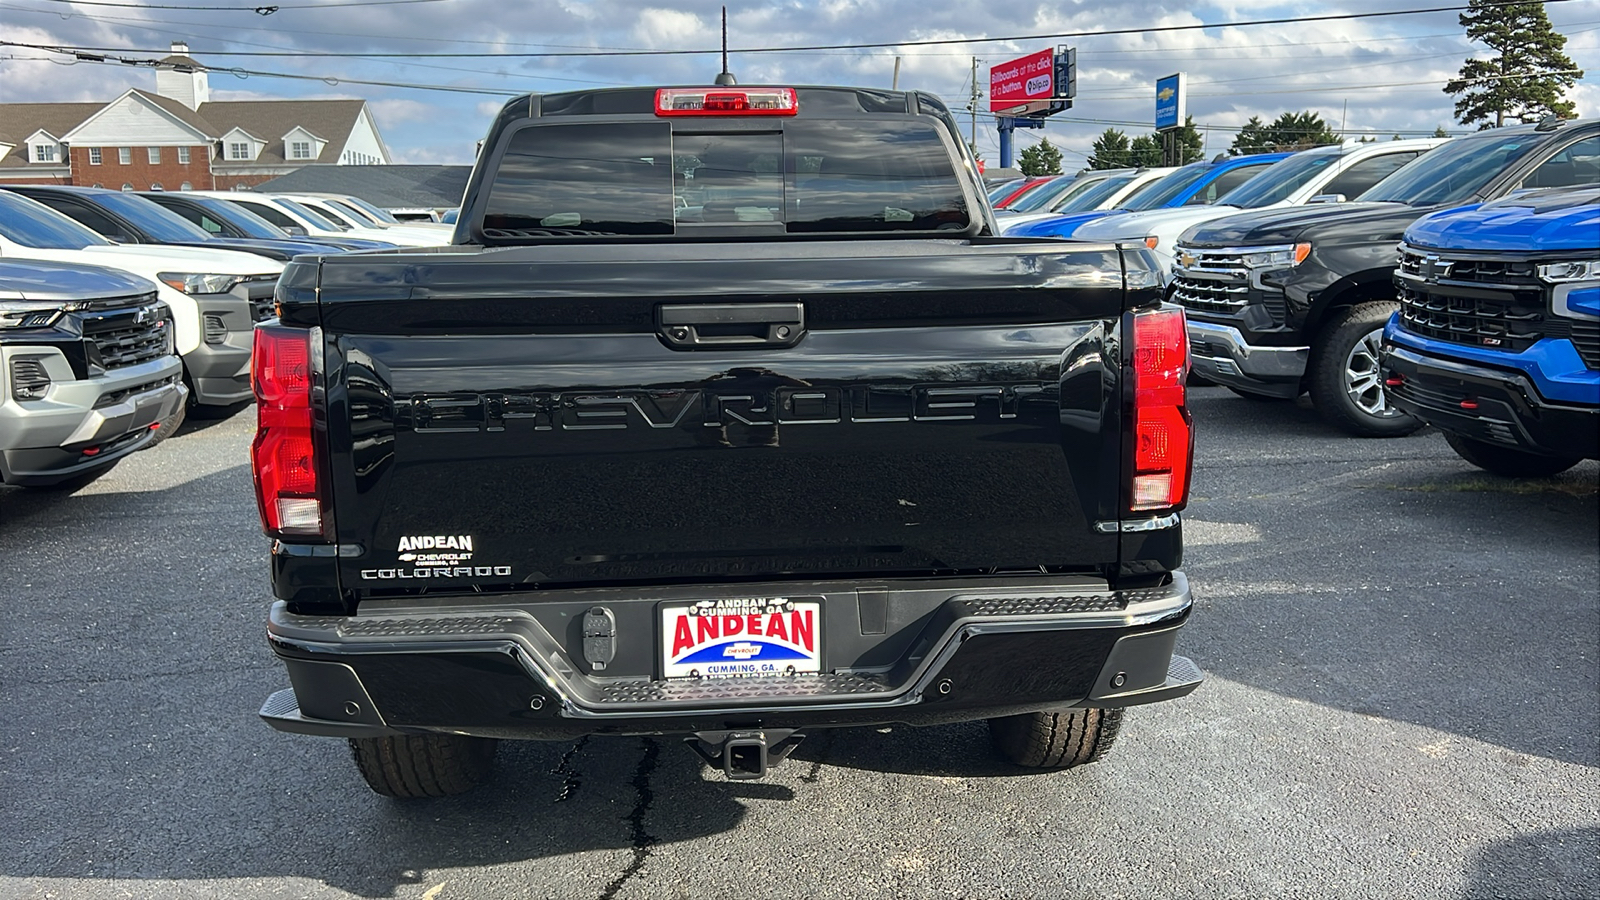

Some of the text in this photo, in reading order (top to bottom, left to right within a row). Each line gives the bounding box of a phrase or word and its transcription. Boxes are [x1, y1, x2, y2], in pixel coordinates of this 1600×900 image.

[992, 56, 1051, 84] Billboards at the click
[991, 86, 997, 97] of
[1032, 80, 1049, 91] blip.co
[411, 384, 1043, 433] CHEVROLET
[398, 535, 473, 552] ANDEAN
[417, 553, 473, 561] CHEVROLET
[361, 566, 512, 580] COLORADO
[716, 598, 766, 609] ANDEAN
[699, 605, 783, 617] CUMMING, GA
[672, 610, 814, 658] ANDEAN
[707, 664, 779, 674] CUMMING, GA.
